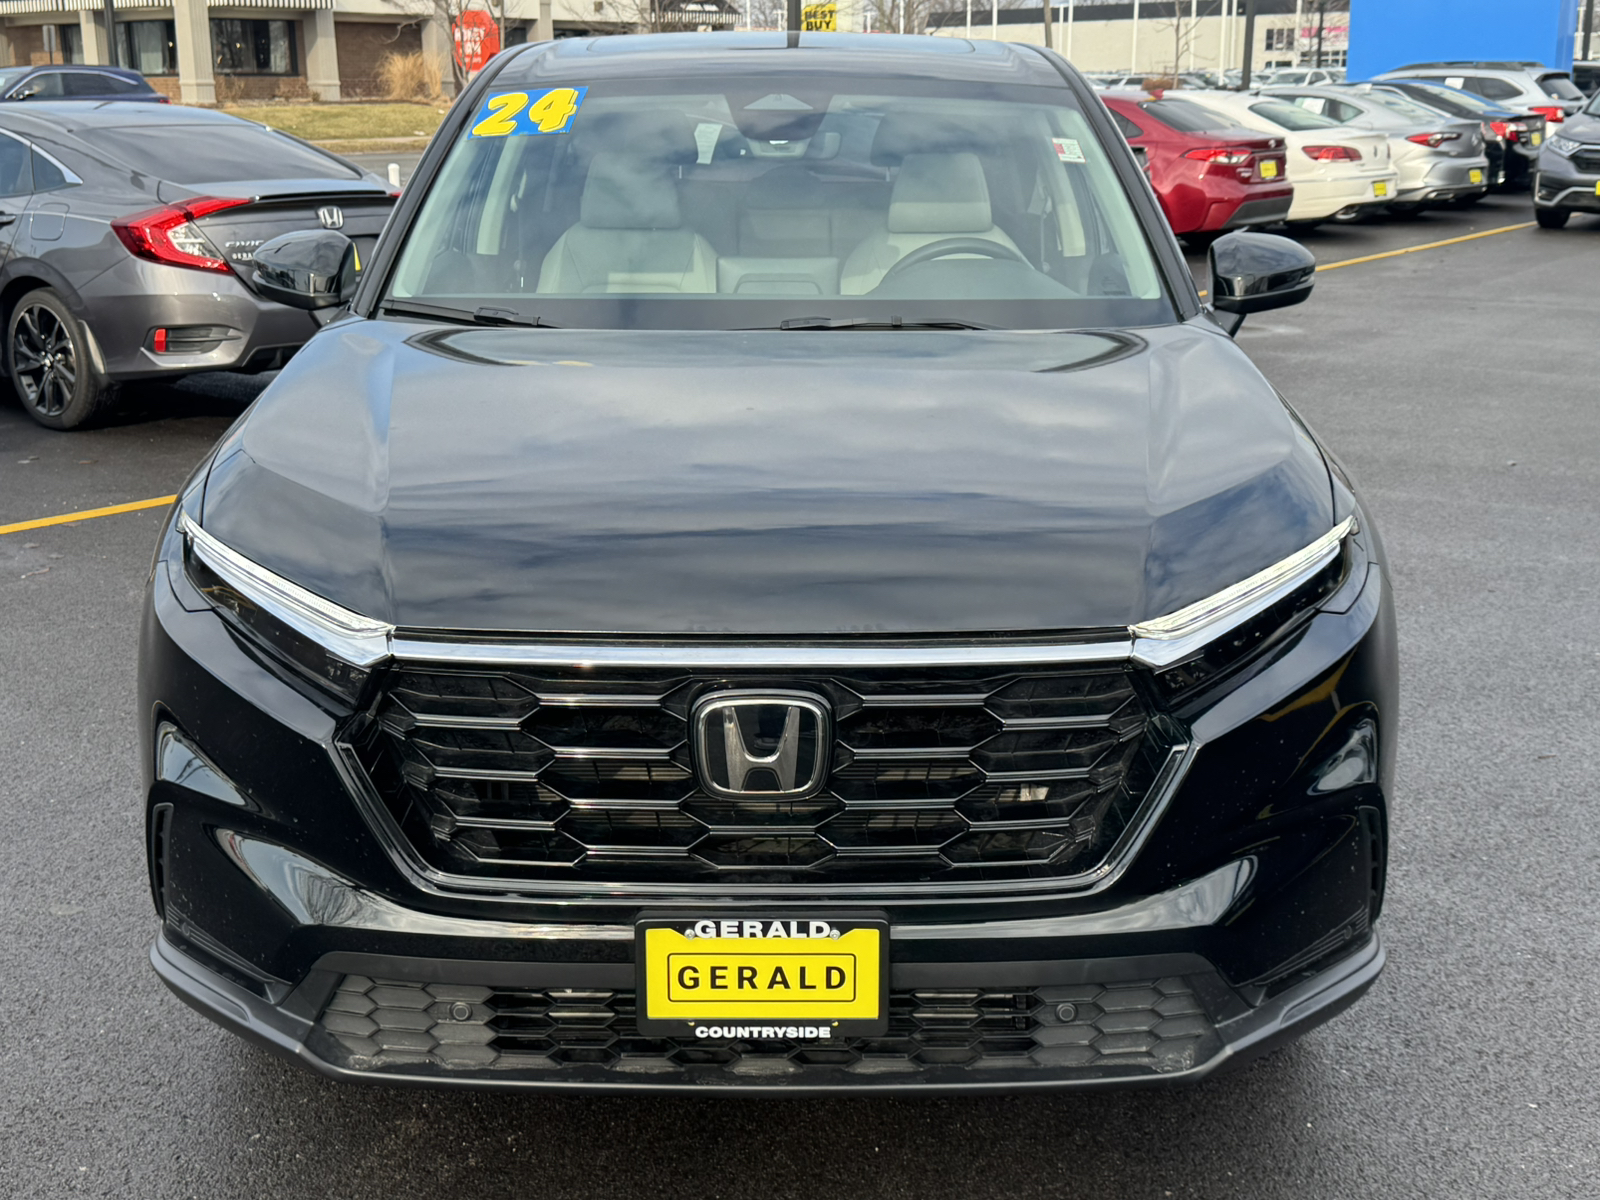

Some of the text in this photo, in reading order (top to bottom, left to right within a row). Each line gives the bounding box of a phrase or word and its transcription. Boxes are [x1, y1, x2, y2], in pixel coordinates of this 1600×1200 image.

[806, 19, 832, 31] BUY
[472, 88, 579, 136] 24
[694, 920, 831, 939] GERALD
[677, 966, 846, 990] GERALD
[695, 1026, 831, 1038] COUNTRYSIDE
